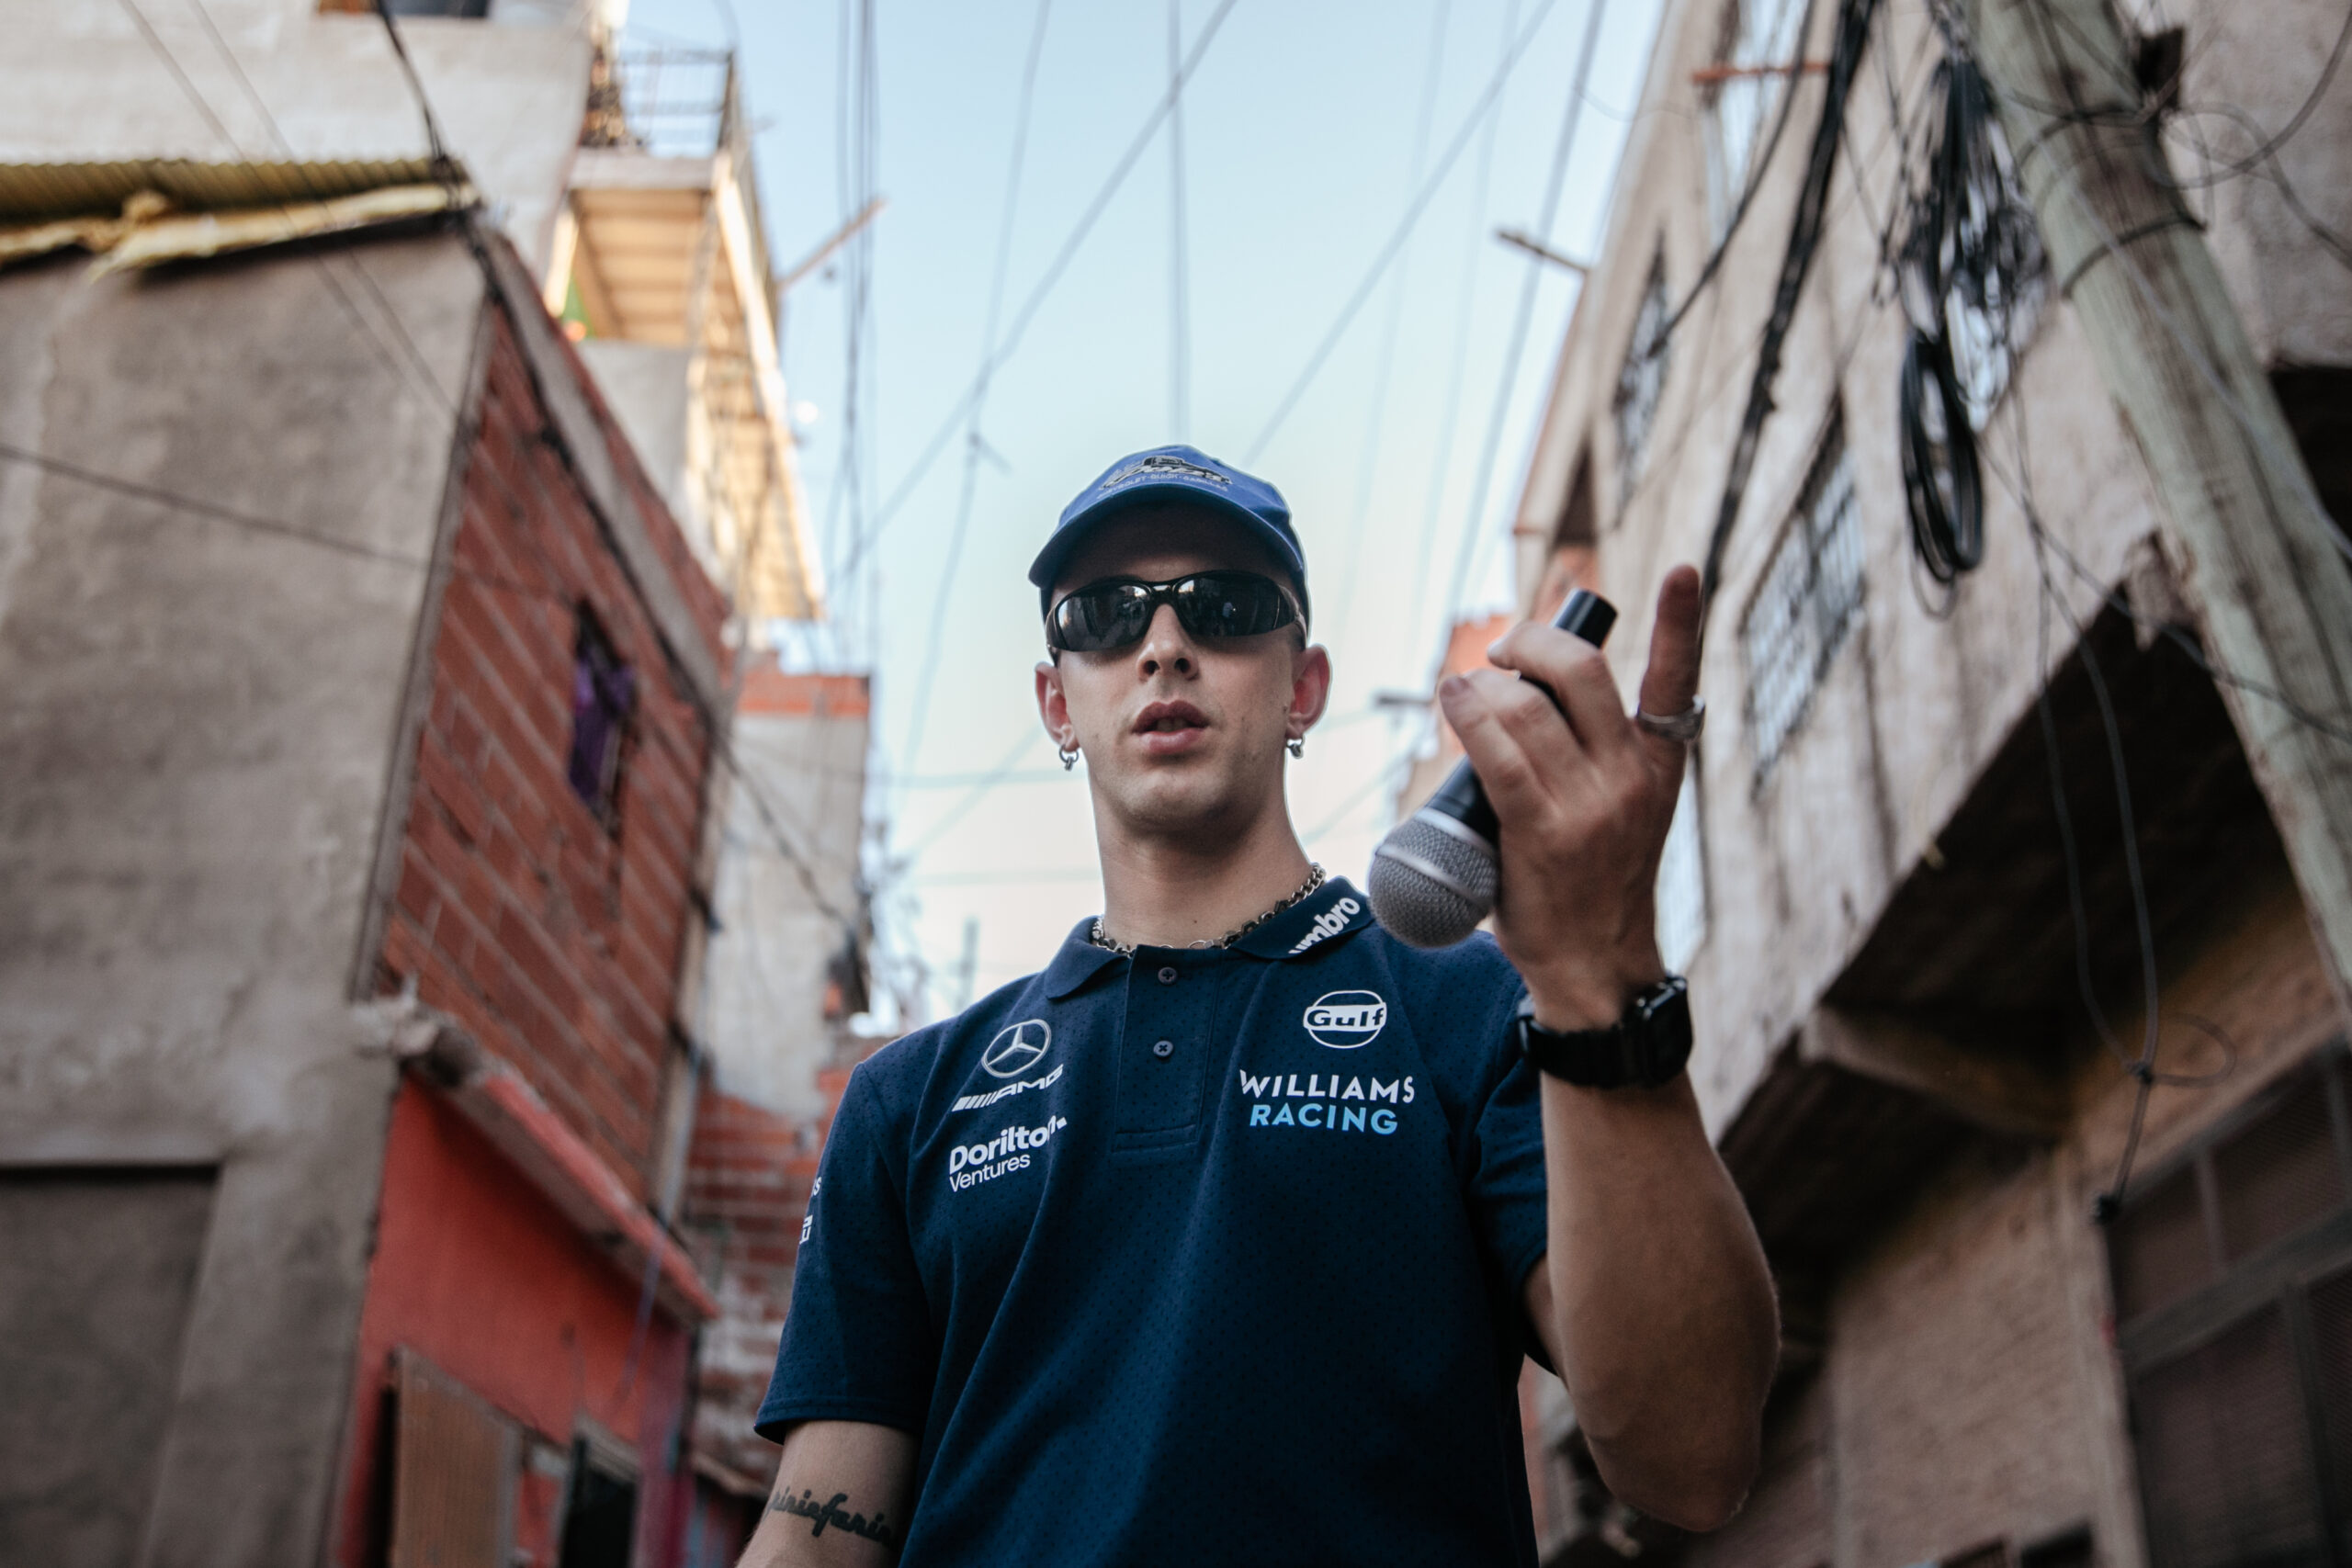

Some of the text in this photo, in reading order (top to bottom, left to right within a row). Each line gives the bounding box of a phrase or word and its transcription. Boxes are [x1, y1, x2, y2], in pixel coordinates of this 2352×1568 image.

[1306, 1007, 1385, 1027] Gulf
[992, 1064, 1063, 1104] AMG
[1239, 1069, 1415, 1103] WILLIAMS
[1250, 1102, 1397, 1134] RACING
[950, 1154, 1030, 1192] Ventures
